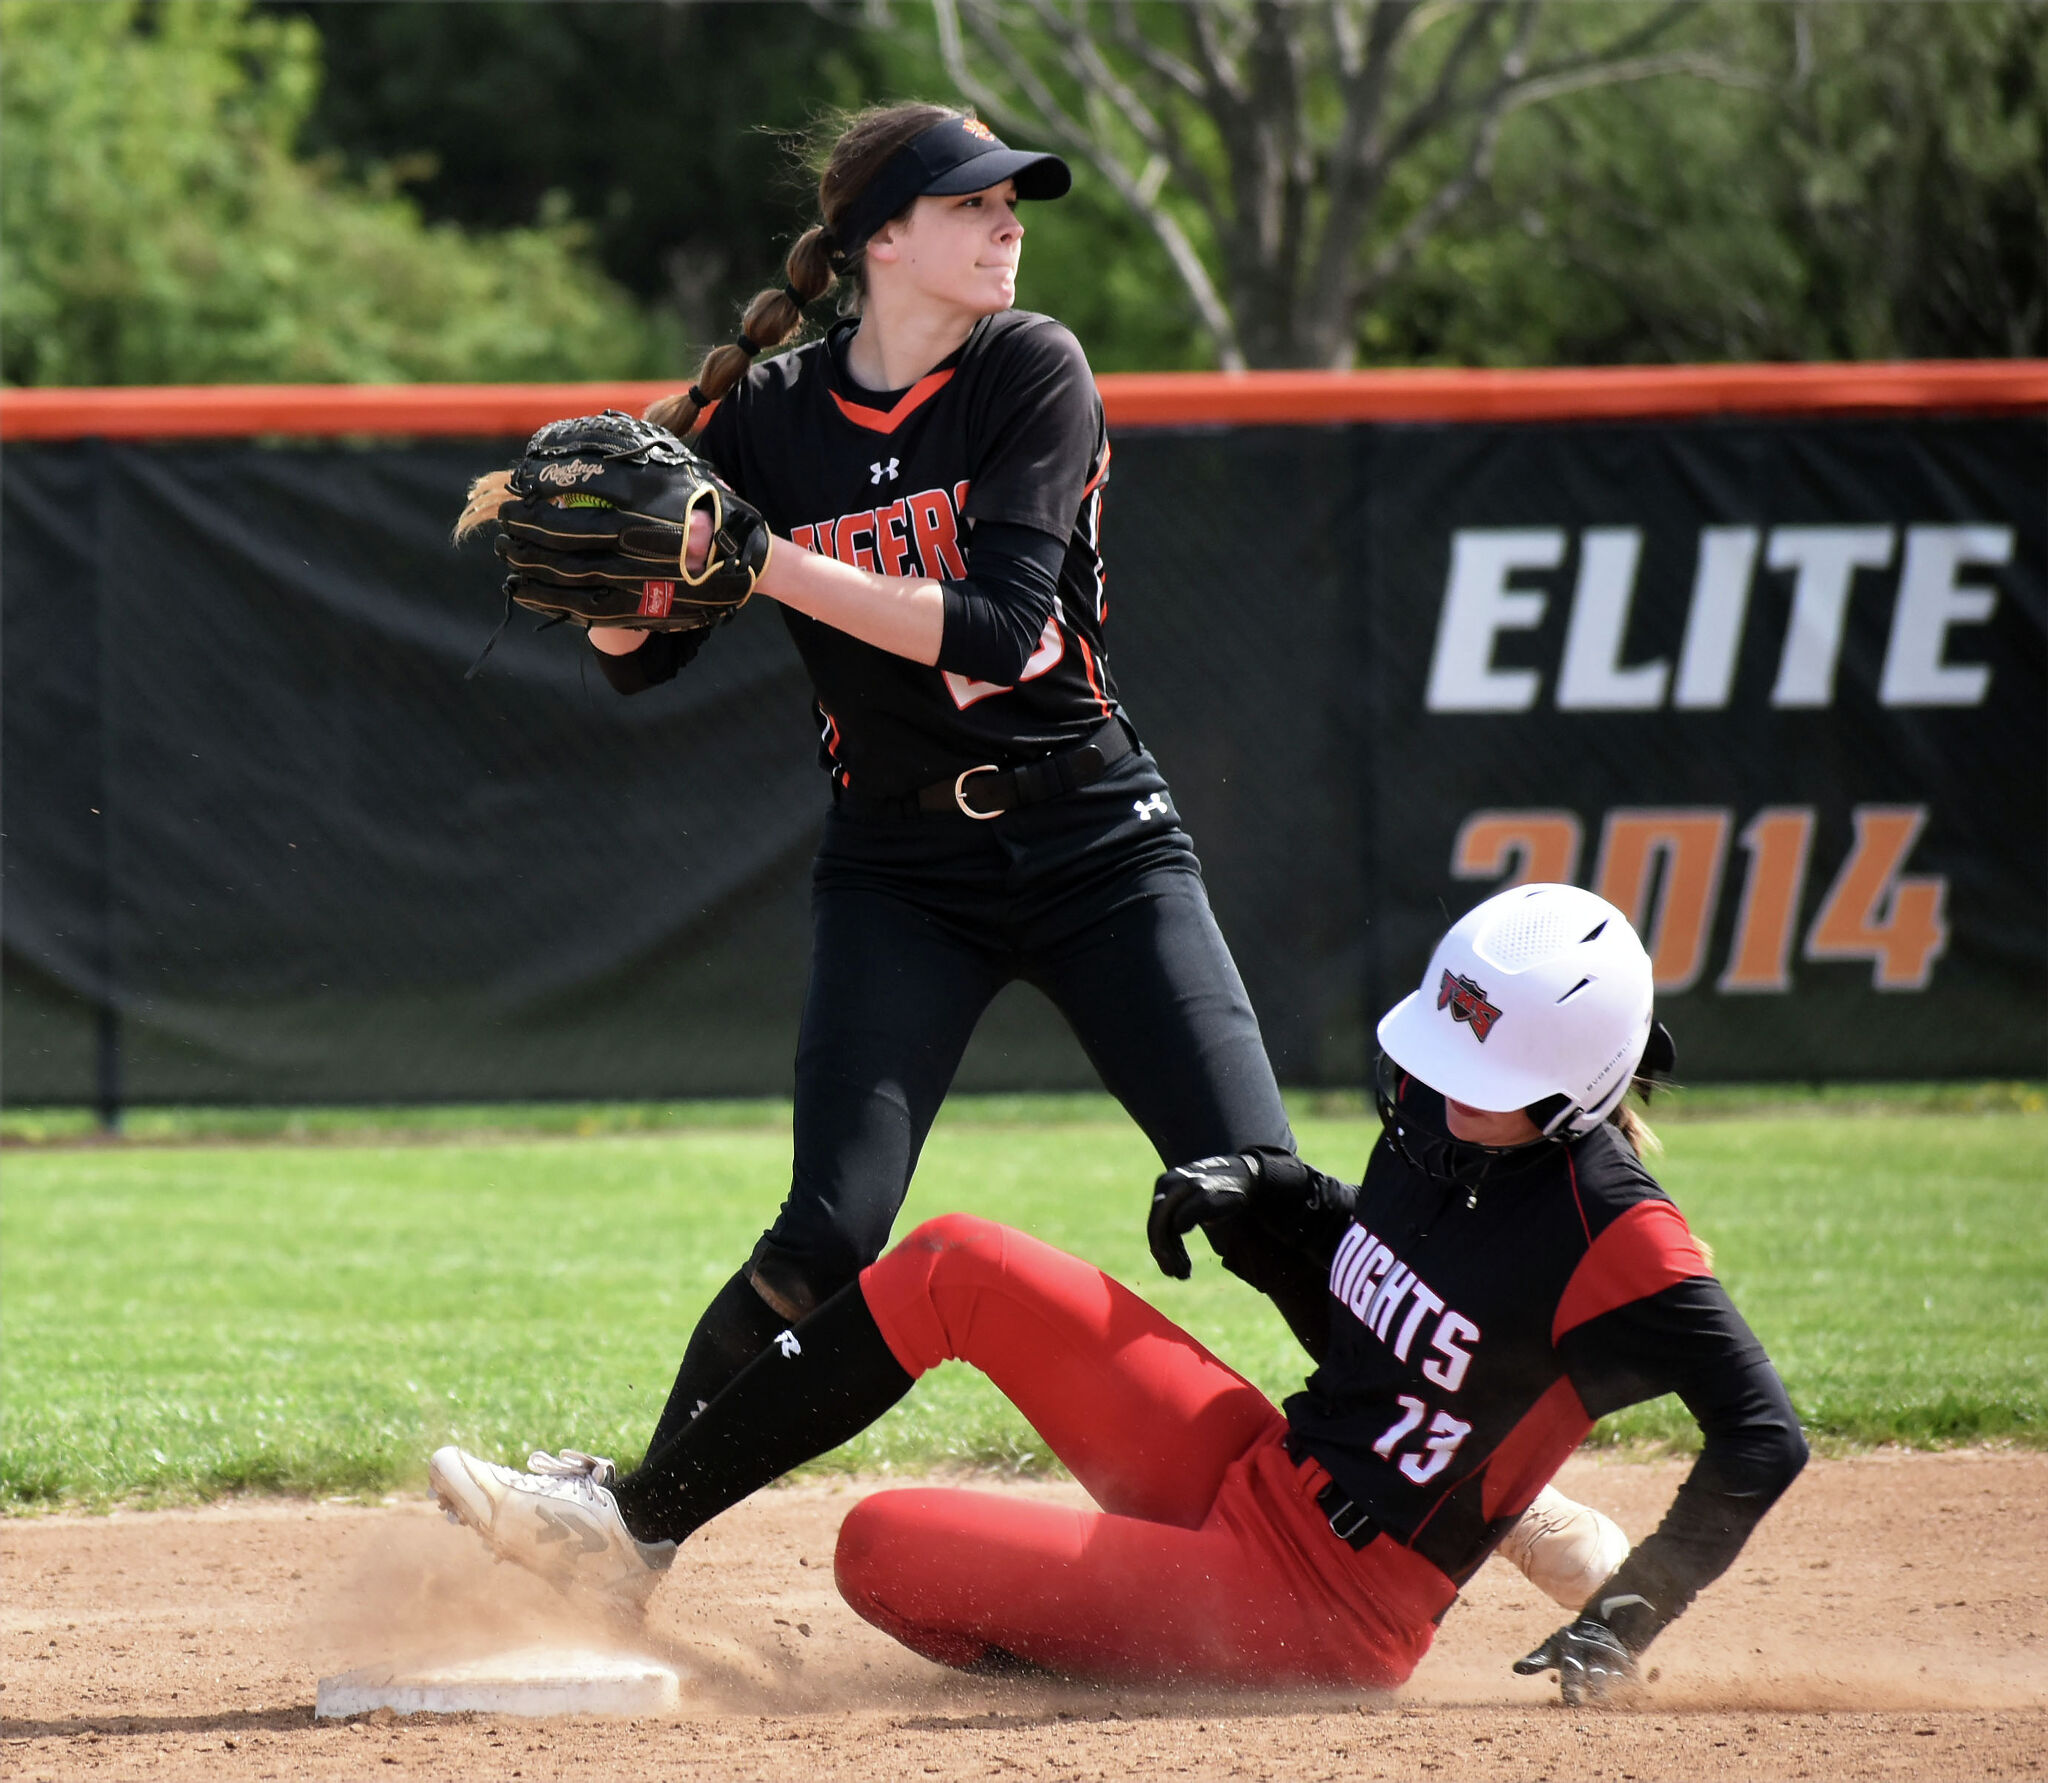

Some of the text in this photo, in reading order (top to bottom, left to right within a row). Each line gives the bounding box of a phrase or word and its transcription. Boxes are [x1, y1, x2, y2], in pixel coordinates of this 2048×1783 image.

[539, 458, 605, 487] Rawlings
[790, 479, 972, 582] IGER
[1426, 523, 2016, 712] ELITE
[1328, 1212, 1482, 1393] NIGHTS
[1371, 1393, 1474, 1487] 13
